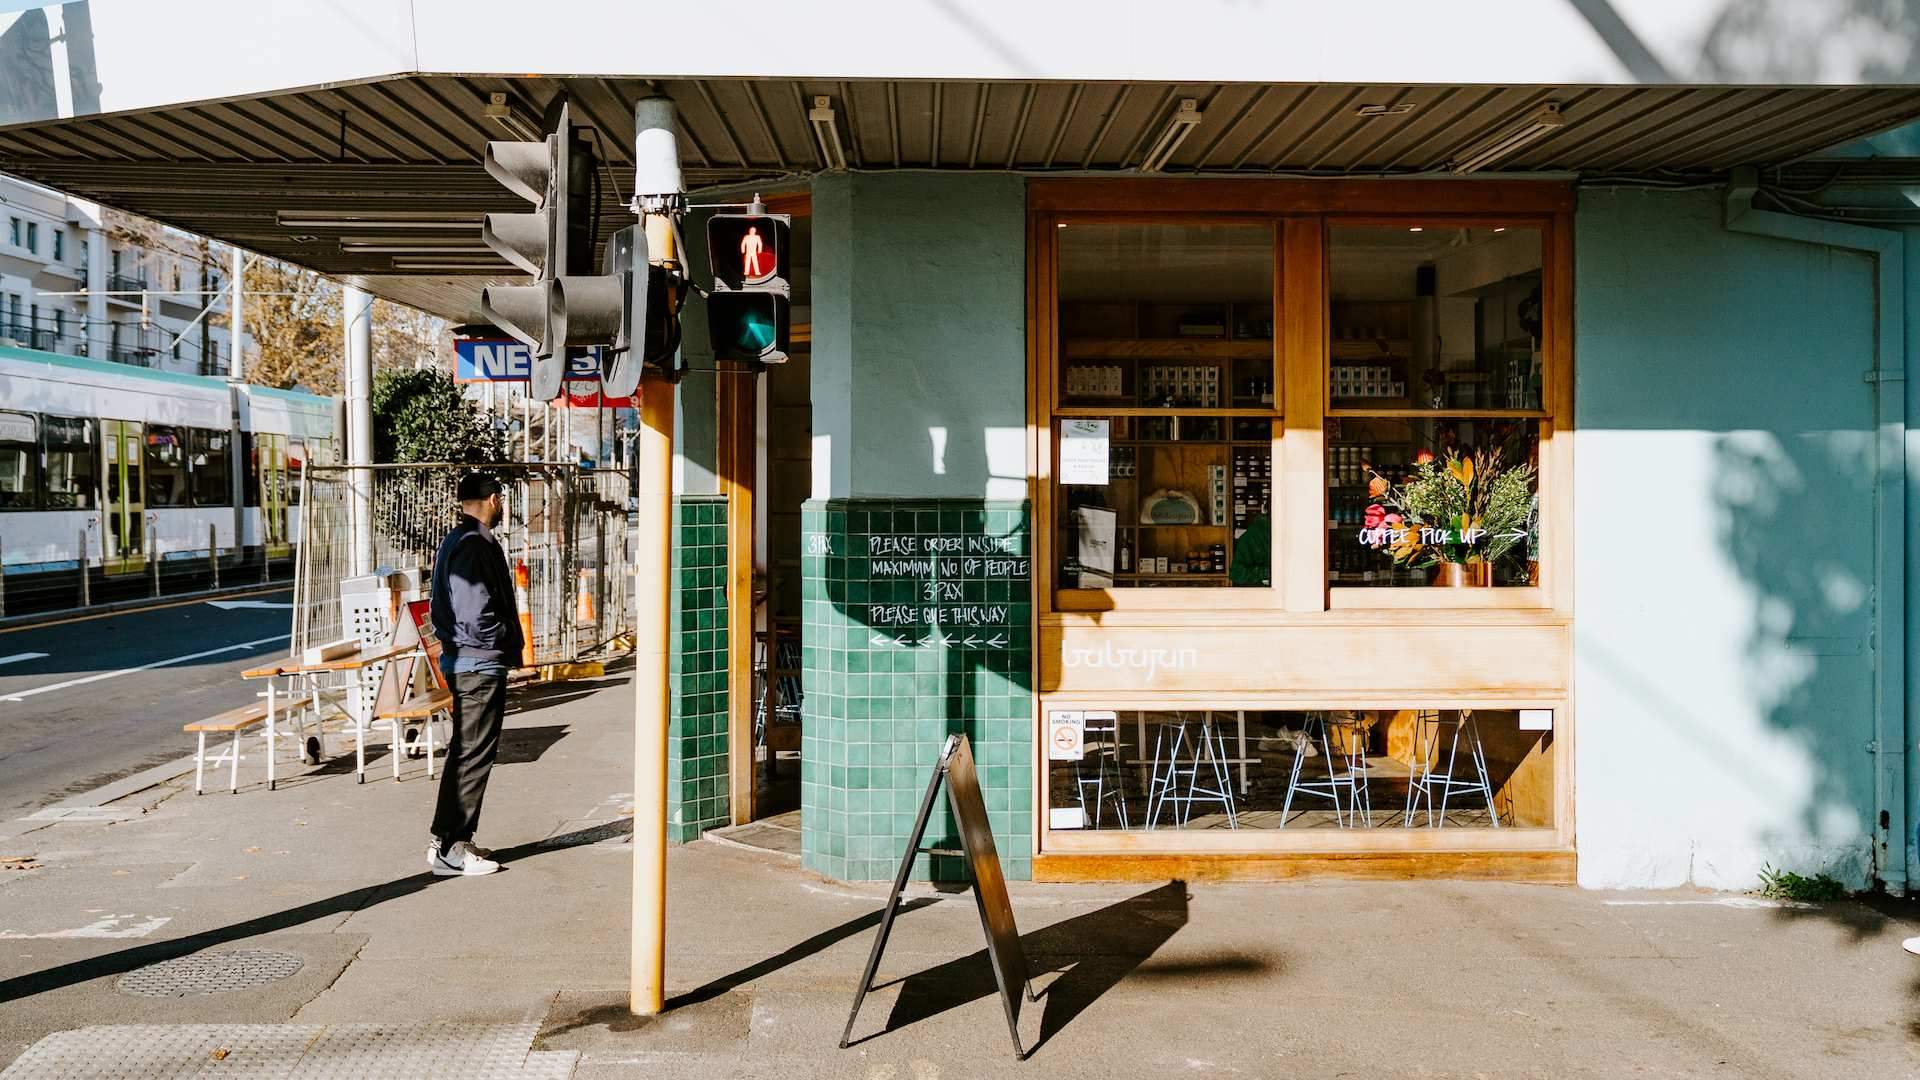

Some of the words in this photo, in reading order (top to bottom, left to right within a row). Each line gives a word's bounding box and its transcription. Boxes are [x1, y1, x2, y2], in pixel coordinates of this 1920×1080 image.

[1359, 528, 1409, 545] COFFEE
[1420, 526, 1453, 545] PICK
[1459, 529, 1488, 545] UP
[869, 536, 917, 555] PLEASE
[924, 537, 963, 552] ORDER
[968, 536, 1018, 553] INSIDE
[872, 559, 936, 579] MAXIMUM
[940, 558, 959, 577] NO.
[964, 558, 981, 576] OF
[985, 559, 1028, 577] PEOPLE
[923, 582, 963, 600] 3PAX
[870, 605, 919, 628] PLEASE
[951, 606, 980, 626] THIS
[980, 605, 1009, 624] WAY
